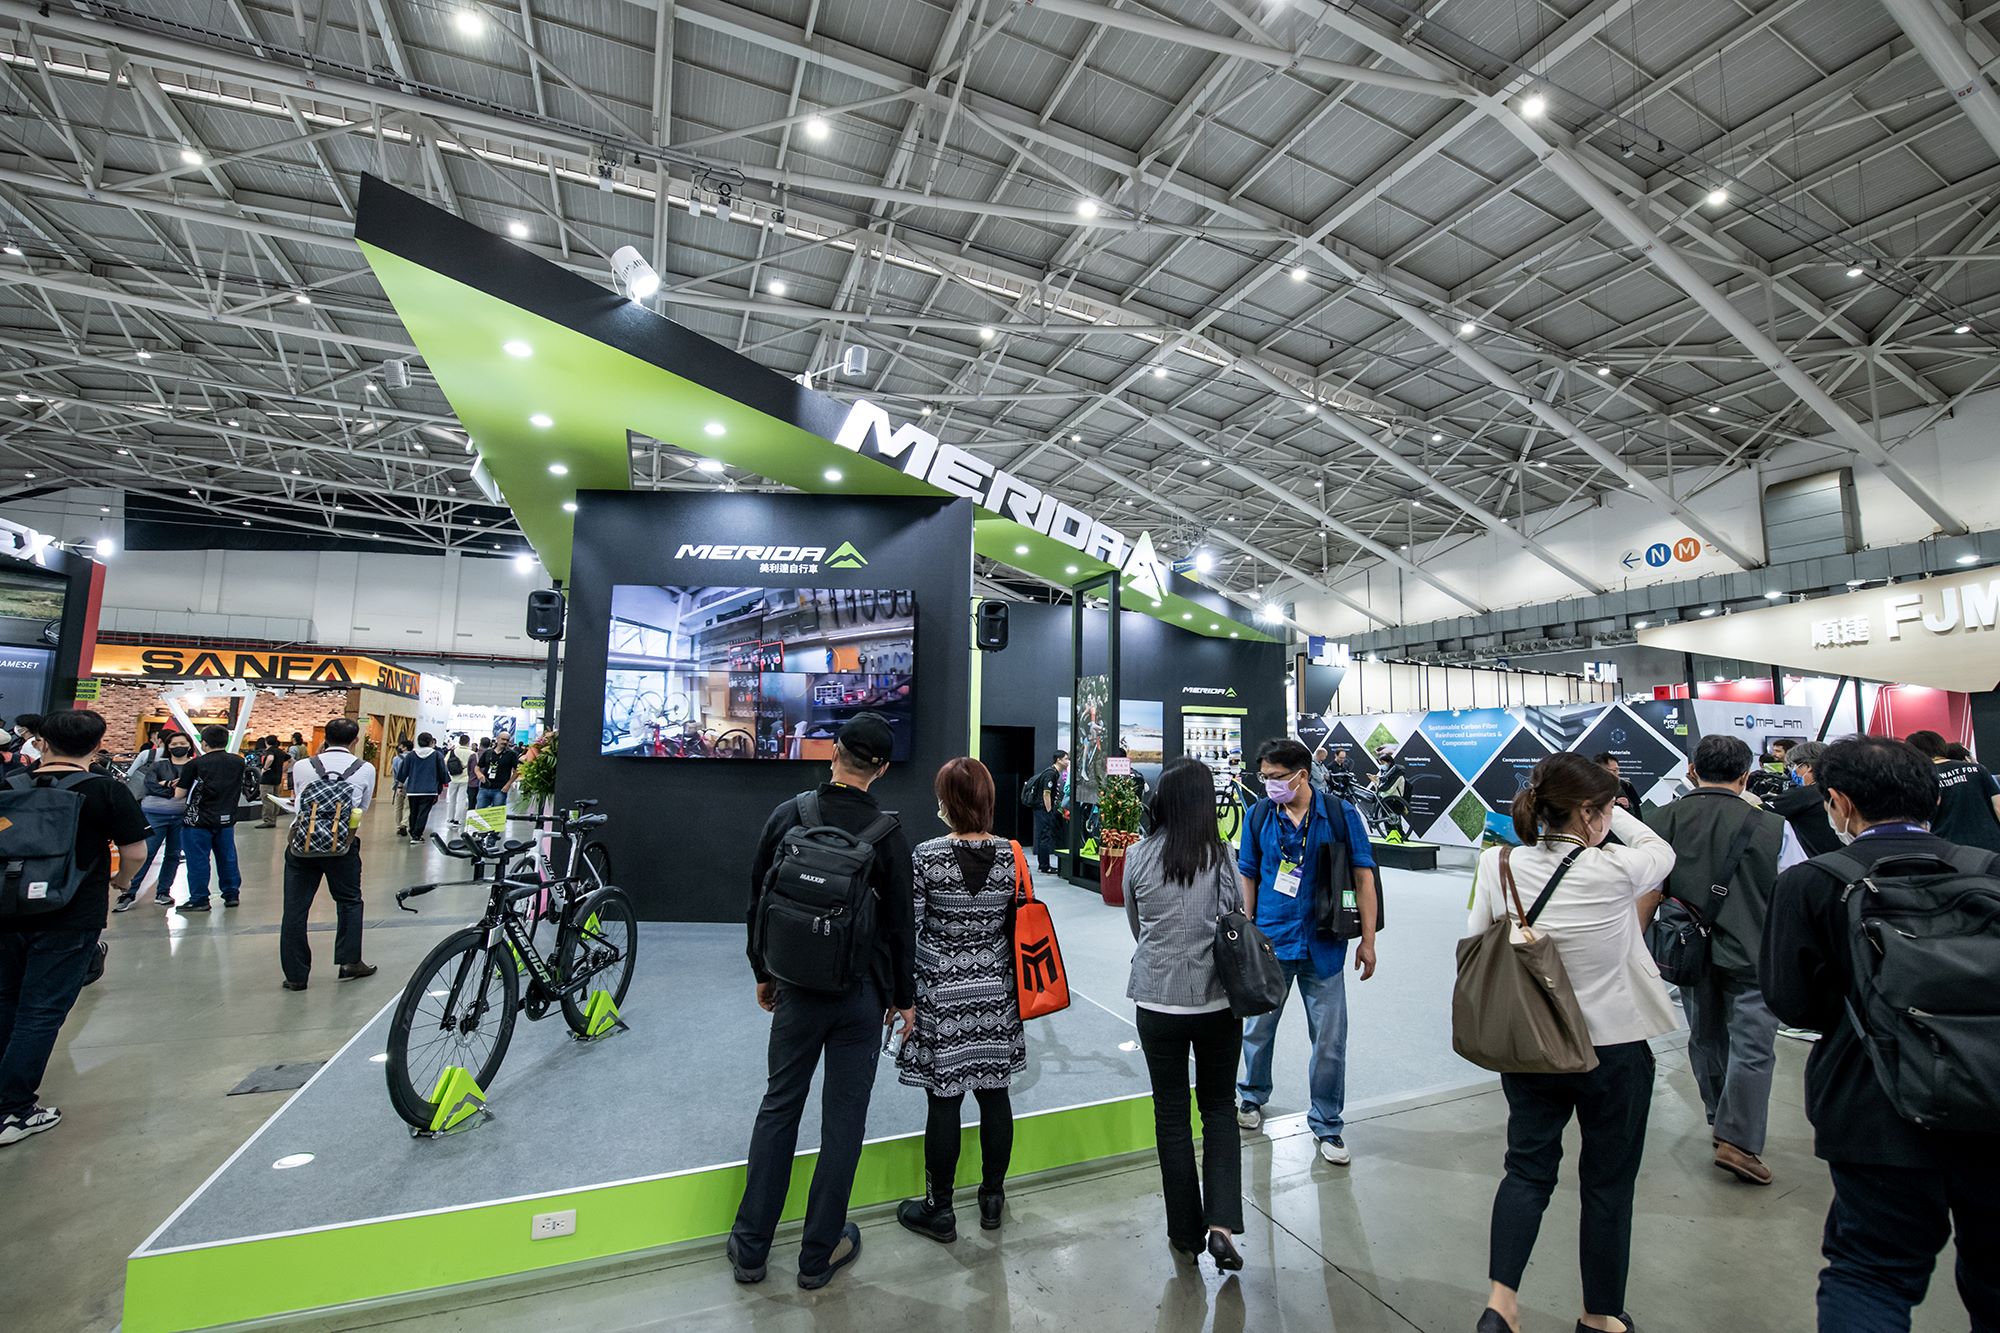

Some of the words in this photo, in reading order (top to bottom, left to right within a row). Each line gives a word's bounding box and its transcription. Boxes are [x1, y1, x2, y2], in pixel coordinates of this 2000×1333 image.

[834, 399, 1125, 569] MERIDA
[674, 544, 827, 561] MERIDA
[1651, 546, 1666, 563] N
[1678, 541, 1695, 559] M
[759, 563, 819, 575] 美利達自行車
[1884, 580, 2000, 641] FJM
[0, 660, 39, 669] AMESET
[141, 650, 352, 682] SANFA
[1584, 662, 1617, 683] FJM
[378, 666, 420, 696] SANFA
[1182, 687, 1225, 695] MERIDA
[1428, 723, 1460, 731] Sustainable
[1734, 715, 1802, 729] COMPLAM
[1939, 768, 1959, 779] WAIT
[1962, 766, 1978, 774] FOR
[509, 922, 551, 982] MERIDA
